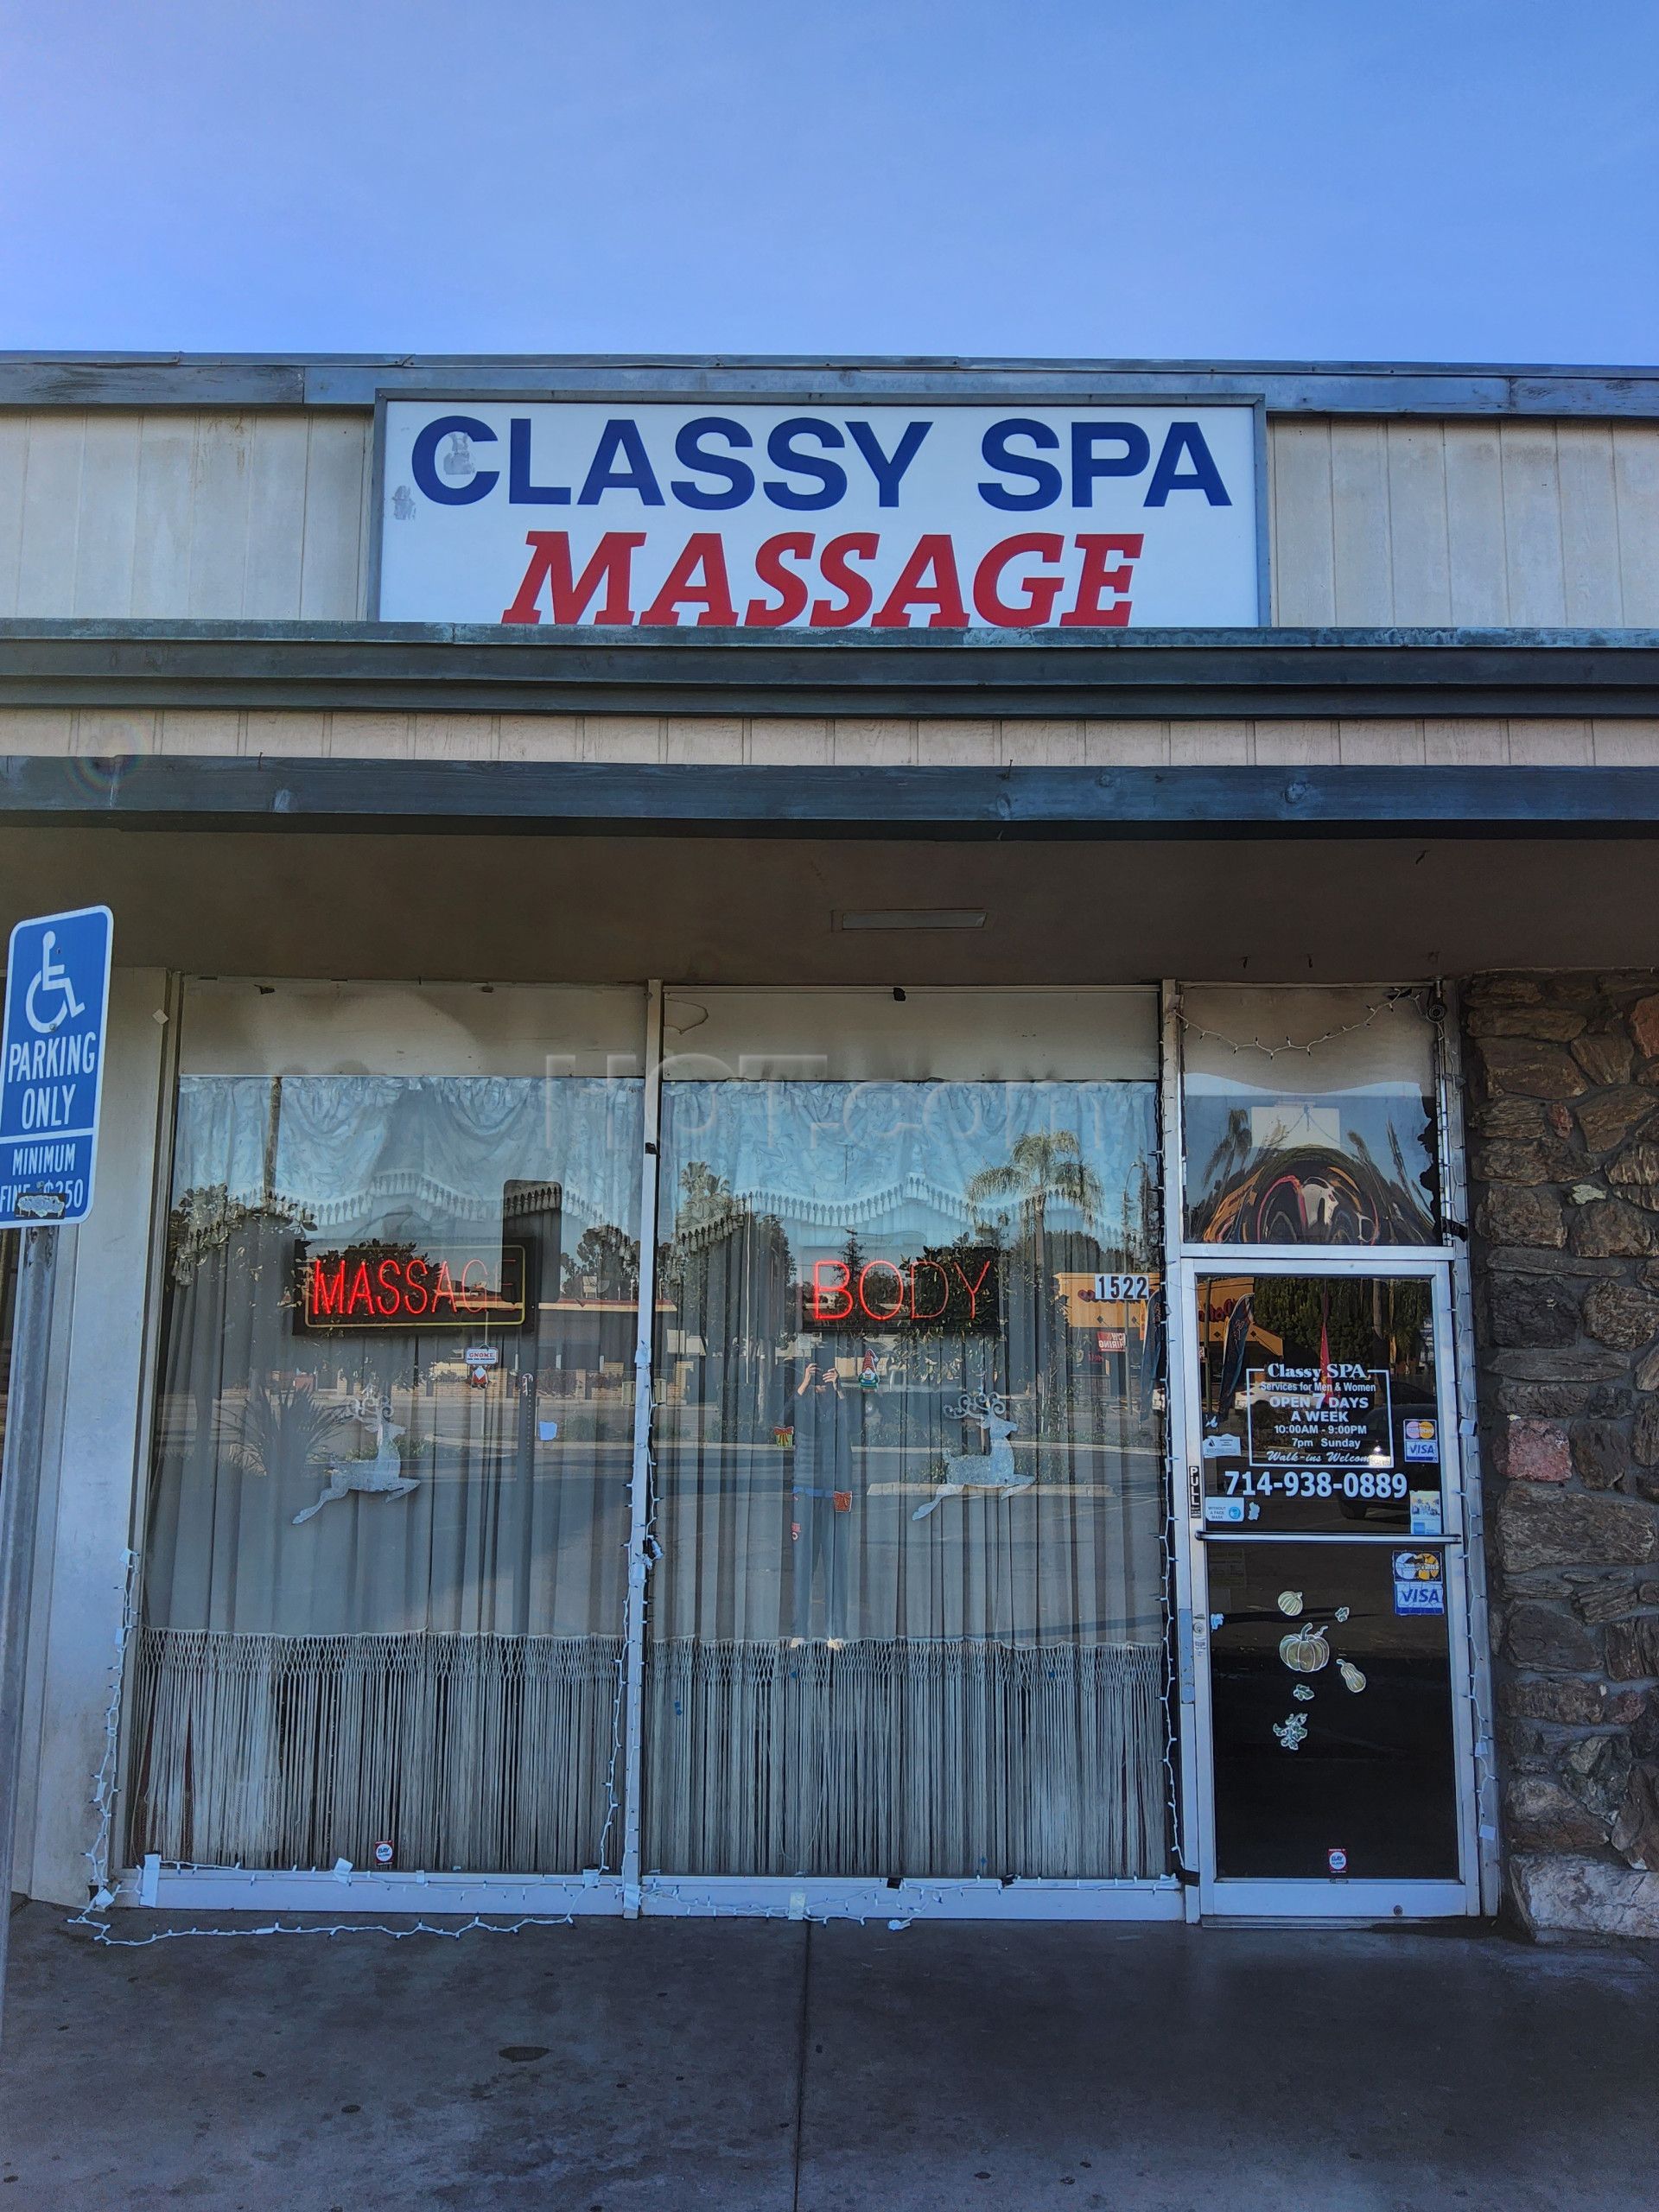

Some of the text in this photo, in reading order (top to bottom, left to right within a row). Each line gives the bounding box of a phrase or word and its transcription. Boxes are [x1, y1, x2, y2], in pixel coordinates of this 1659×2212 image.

[411, 416, 1231, 512] CLASSY SPA
[501, 530, 1144, 627] MASSAGE
[8, 1032, 97, 1083] PARKING
[22, 1084, 76, 1130] ONLY
[12, 1143, 76, 1176] MINIMUM
[813, 1260, 991, 1320] BODY
[1098, 1275, 1147, 1299] 1522
[1268, 1363, 1367, 1382] Classy SPA
[1261, 1382, 1376, 1392] Services for Men & Women
[1269, 1393, 1369, 1409] OPEN 7 DAYS
[1291, 1411, 1349, 1422] A WEEK
[1274, 1425, 1319, 1434] 10:00AM
[1328, 1425, 1367, 1434] 9:00PM
[1292, 1438, 1361, 1449] 7pm Sunday
[1410, 1445, 1434, 1454] VISA
[1266, 1451, 1372, 1462] Walk-ins Welcom
[1190, 1466, 1200, 1505] PULL
[1224, 1471, 1408, 1498] 714-938-0889
[1402, 1588, 1440, 1603] VISA
